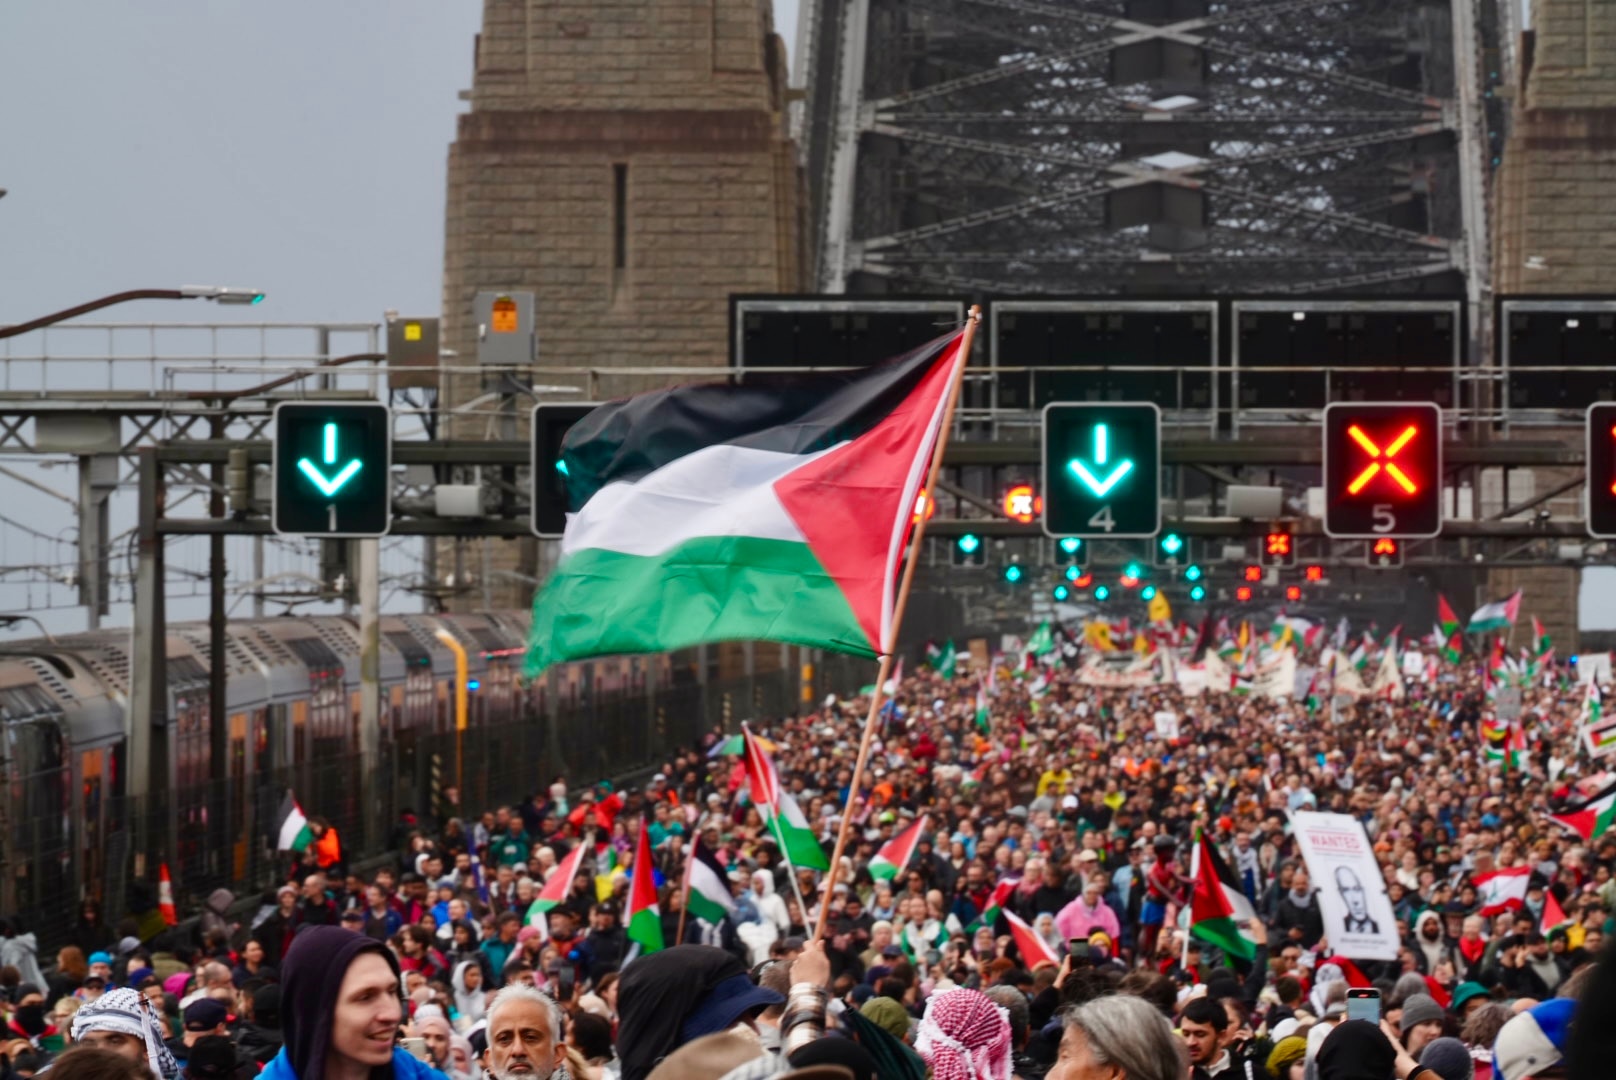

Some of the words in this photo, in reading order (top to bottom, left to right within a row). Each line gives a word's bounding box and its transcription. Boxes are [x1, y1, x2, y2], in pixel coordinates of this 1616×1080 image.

[326, 504, 337, 532] 1
[1088, 505, 1116, 532] 4
[1373, 504, 1396, 532] 5
[1308, 834, 1361, 849] WANTED
